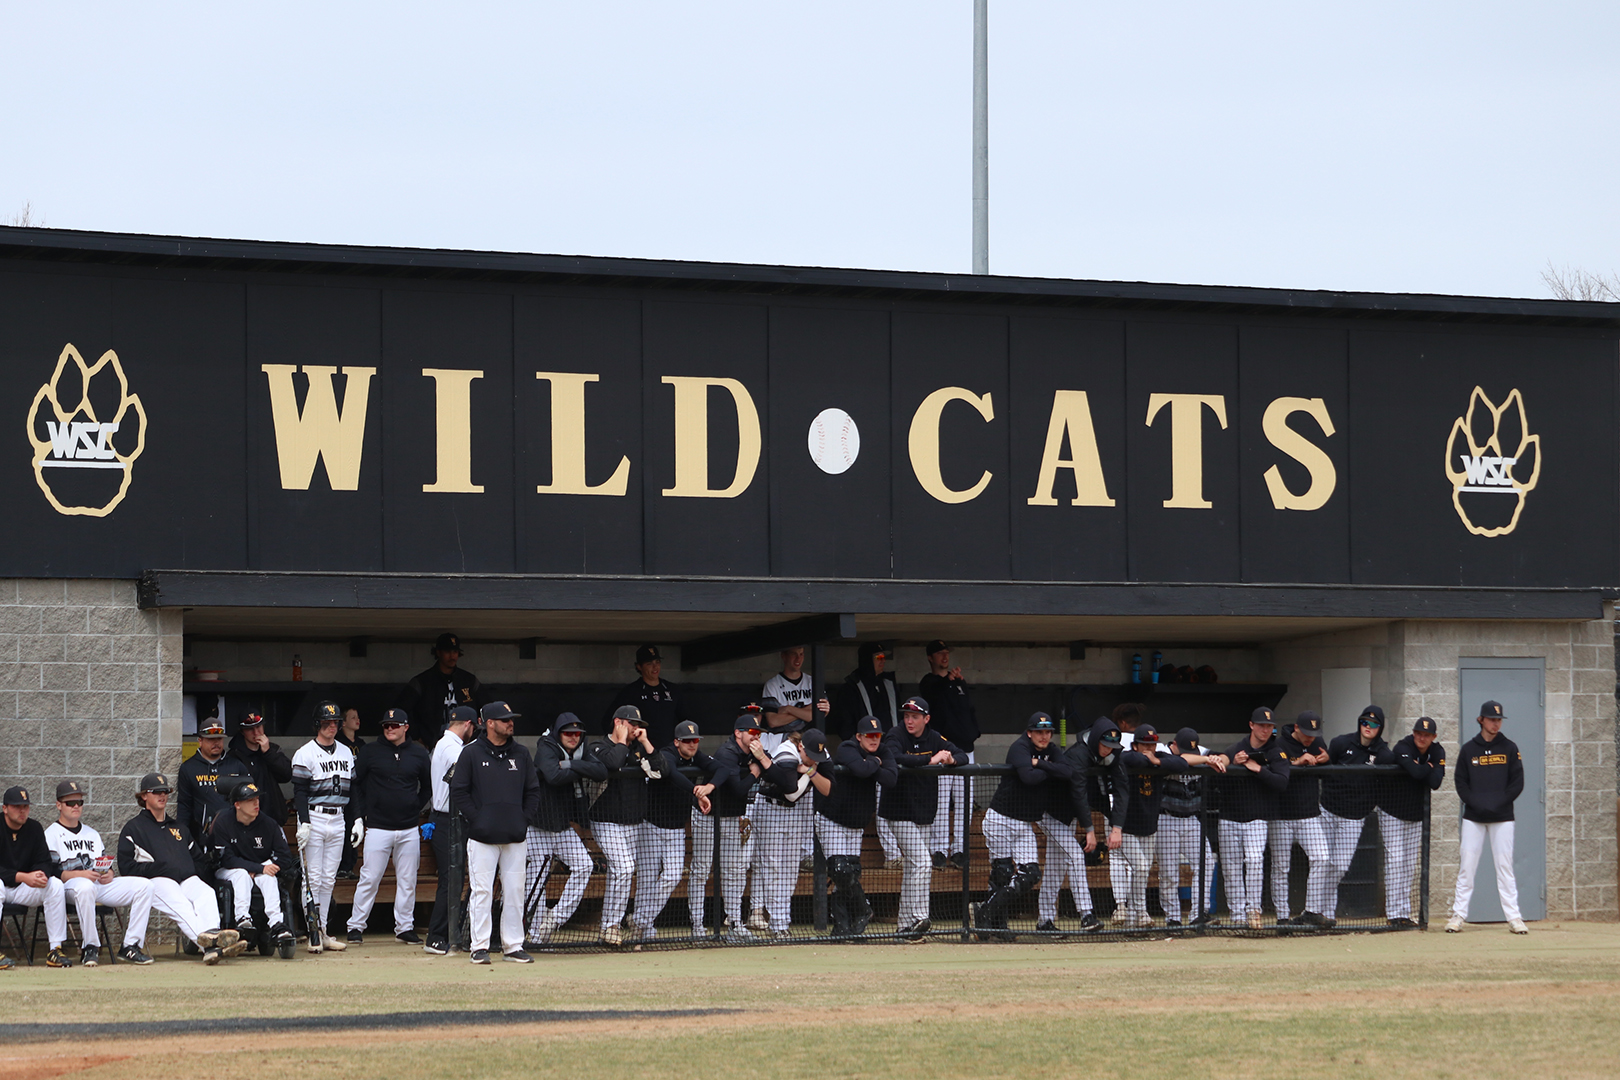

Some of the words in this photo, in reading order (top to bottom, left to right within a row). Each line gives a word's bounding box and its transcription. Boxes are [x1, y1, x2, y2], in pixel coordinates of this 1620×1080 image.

[46, 421, 119, 459] WSC
[261, 363, 762, 498] WILD
[908, 386, 1337, 511] CATS
[1460, 455, 1517, 485] WSC
[320, 760, 349, 773] WAYNE
[63, 839, 95, 853] WAYNE
